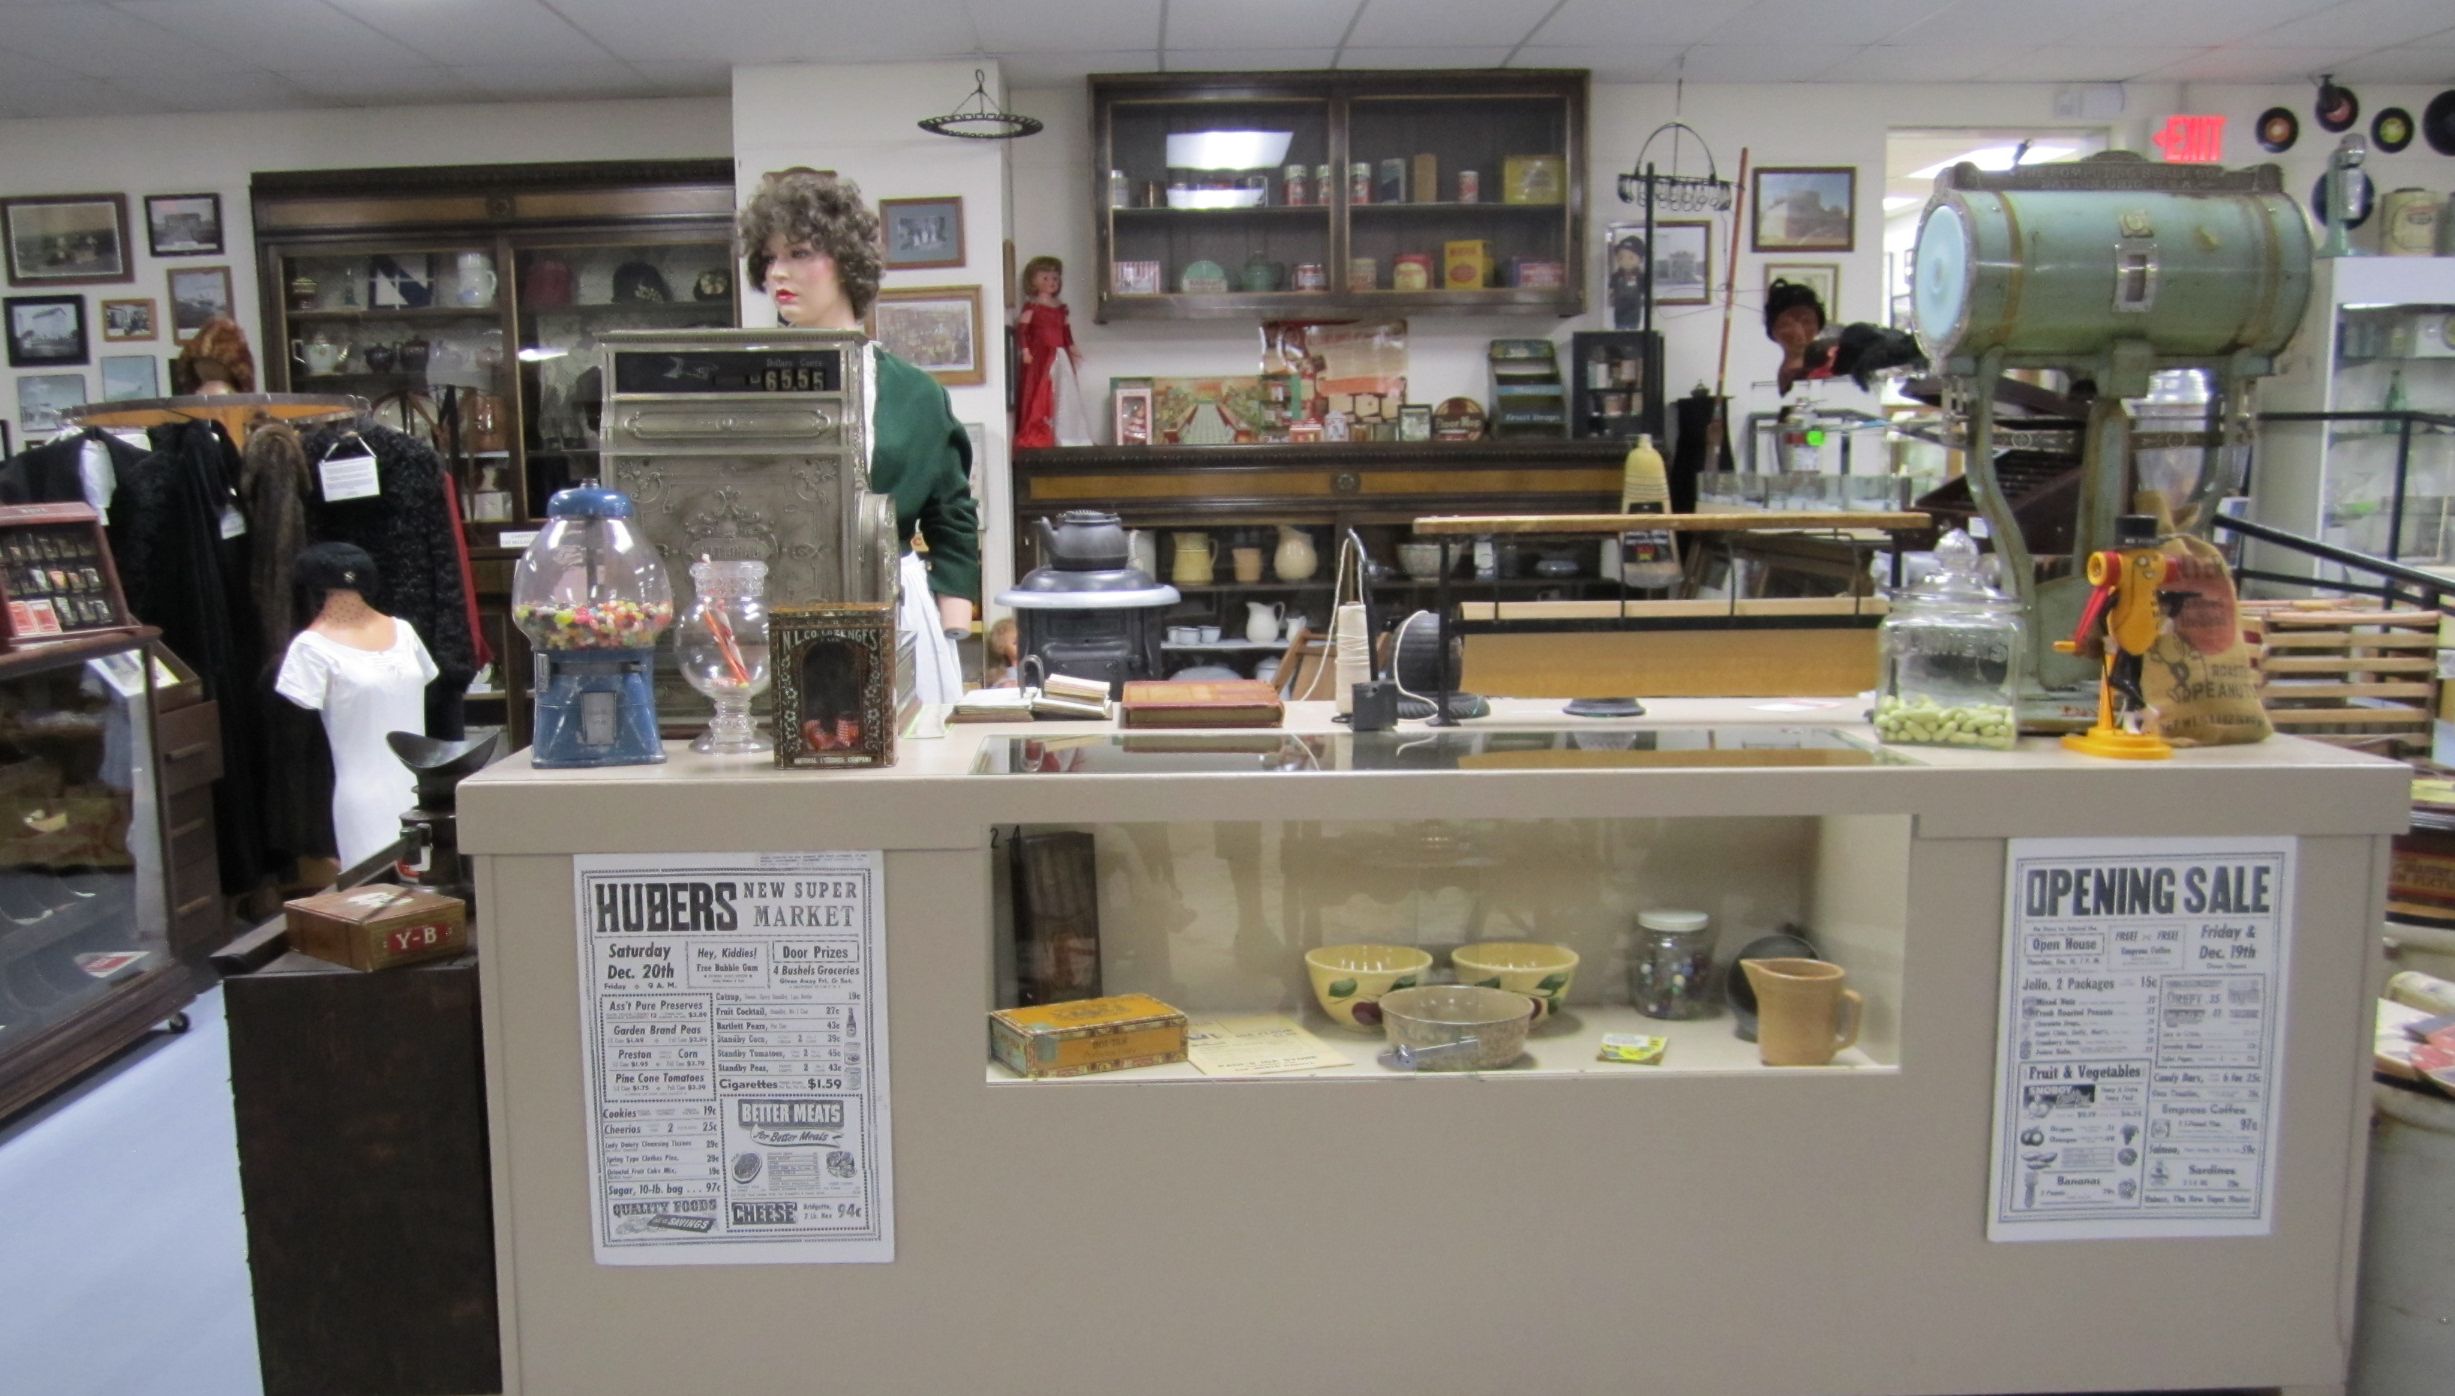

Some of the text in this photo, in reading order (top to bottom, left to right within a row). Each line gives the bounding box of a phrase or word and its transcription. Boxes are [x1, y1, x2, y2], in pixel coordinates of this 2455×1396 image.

[2166, 116, 2227, 162] EXIT
[743, 882, 857, 898] NEW SUPER
[2025, 865, 2271, 917] OPENING SALE
[595, 881, 738, 932] HUBERS
[752, 905, 855, 927] MARKET
[395, 926, 438, 950] Y-B
[2201, 923, 2242, 941] Friday
[609, 941, 671, 960] Saturday
[782, 945, 848, 958] Door Prizes
[2032, 937, 2097, 952] Open House
[2198, 943, 2256, 959] Dec. 19th
[697, 947, 757, 959] Hey, Kiddies!
[608, 965, 635, 979] Dec.
[642, 962, 674, 978] 20th
[696, 963, 758, 972] Free Bubble Gum
[773, 964, 860, 976] 4 Bushels Groceries
[2022, 977, 2051, 991] Jello,
[2067, 976, 2115, 992] Packages
[609, 1000, 703, 1011] Ass't Pure Preserves
[716, 1007, 733, 1016] Fruit
[613, 1024, 702, 1036] Garden Brand Peas
[618, 1048, 698, 1060] Preston Corn
[615, 1072, 705, 1084] Pine Cone Tomatoes
[2029, 1064, 2141, 1082] Fruit & Vegetables
[719, 1078, 778, 1091] Cigarettes
[807, 1077, 842, 1090] $1.59
[603, 1108, 637, 1119] Cookies
[742, 1103, 840, 1123] BETTER MEATS
[604, 1124, 641, 1135] Cheerios
[770, 1131, 797, 1142] Better
[2057, 1175, 2101, 1186] Bananas
[608, 1185, 636, 1196] Sugar,
[667, 1183, 683, 1195] bag
[613, 1199, 717, 1217] QUALITY FOODS
[733, 1202, 795, 1222] CHEESE
[668, 1217, 709, 1229] SAVINGS
